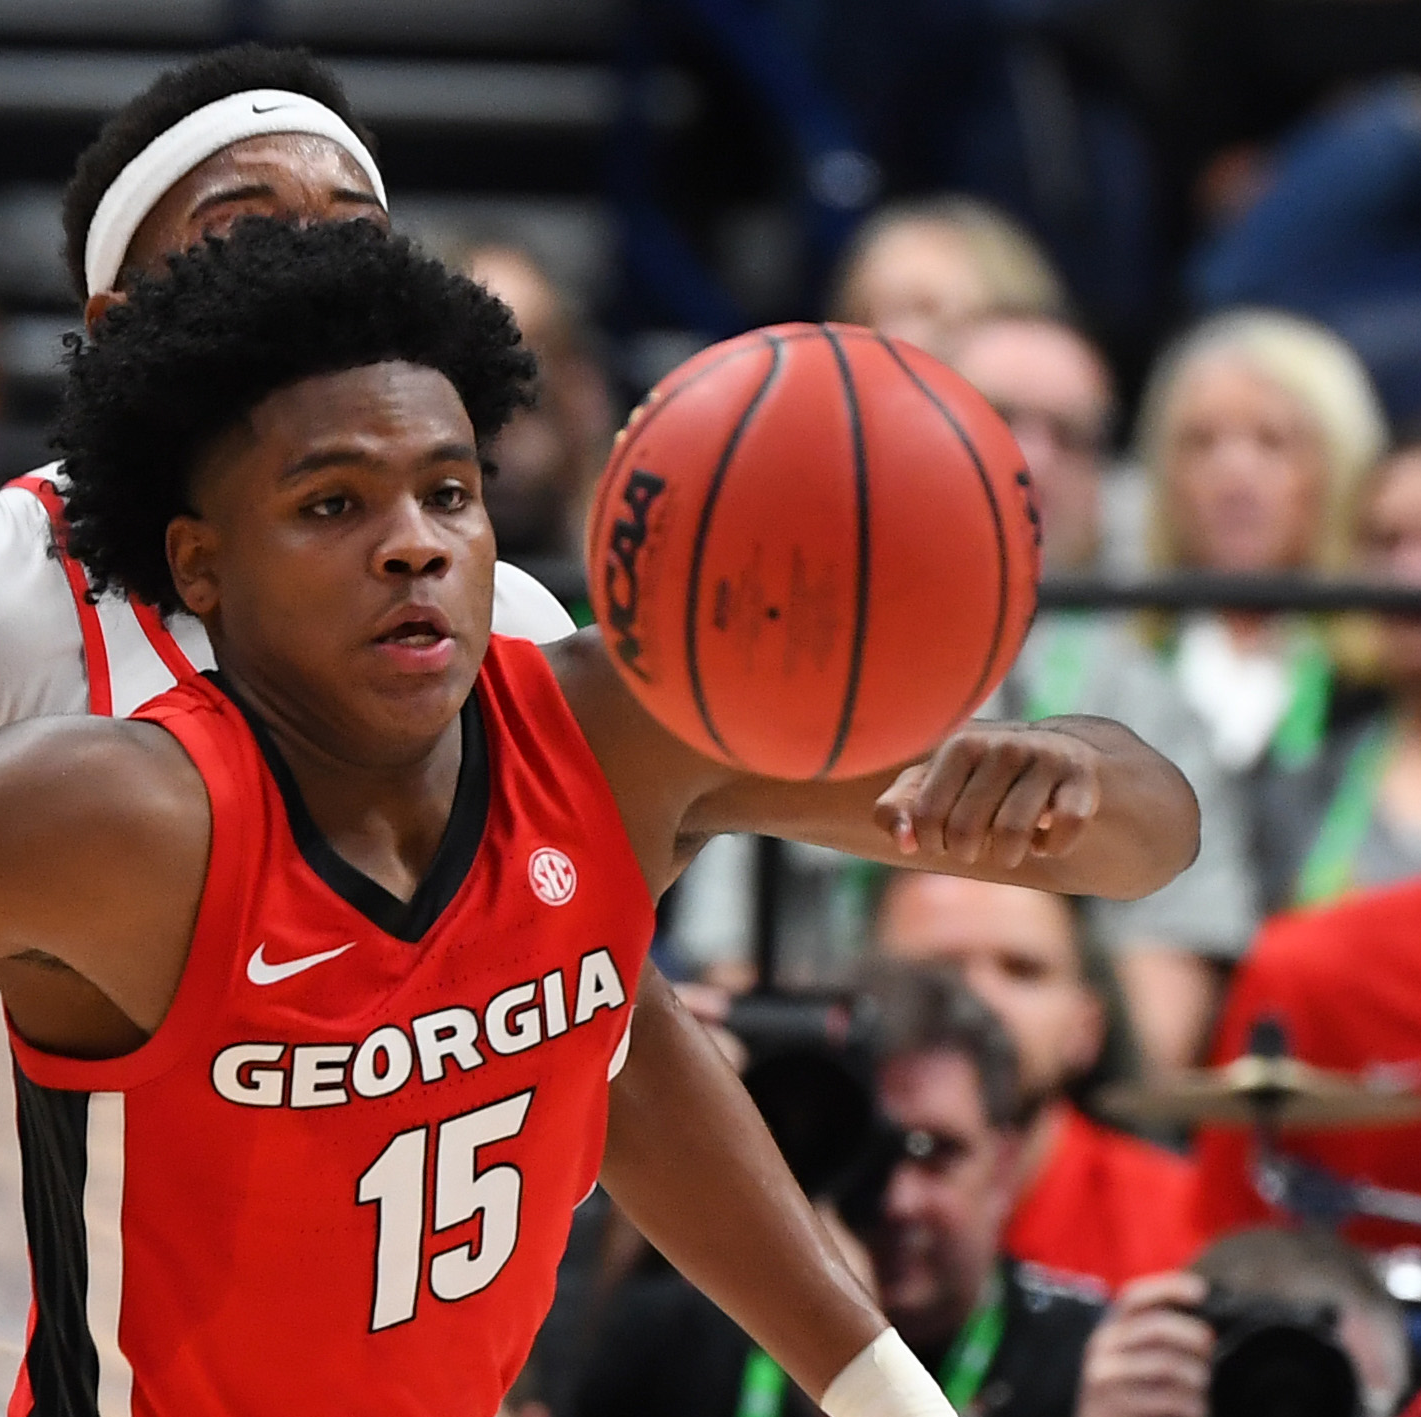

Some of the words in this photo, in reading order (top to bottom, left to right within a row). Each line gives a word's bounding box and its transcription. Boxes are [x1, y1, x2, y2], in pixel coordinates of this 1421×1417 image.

[533, 853, 573, 899] SEC
[211, 948, 627, 1109] GEORGIA
[356, 1085, 536, 1333] 15
